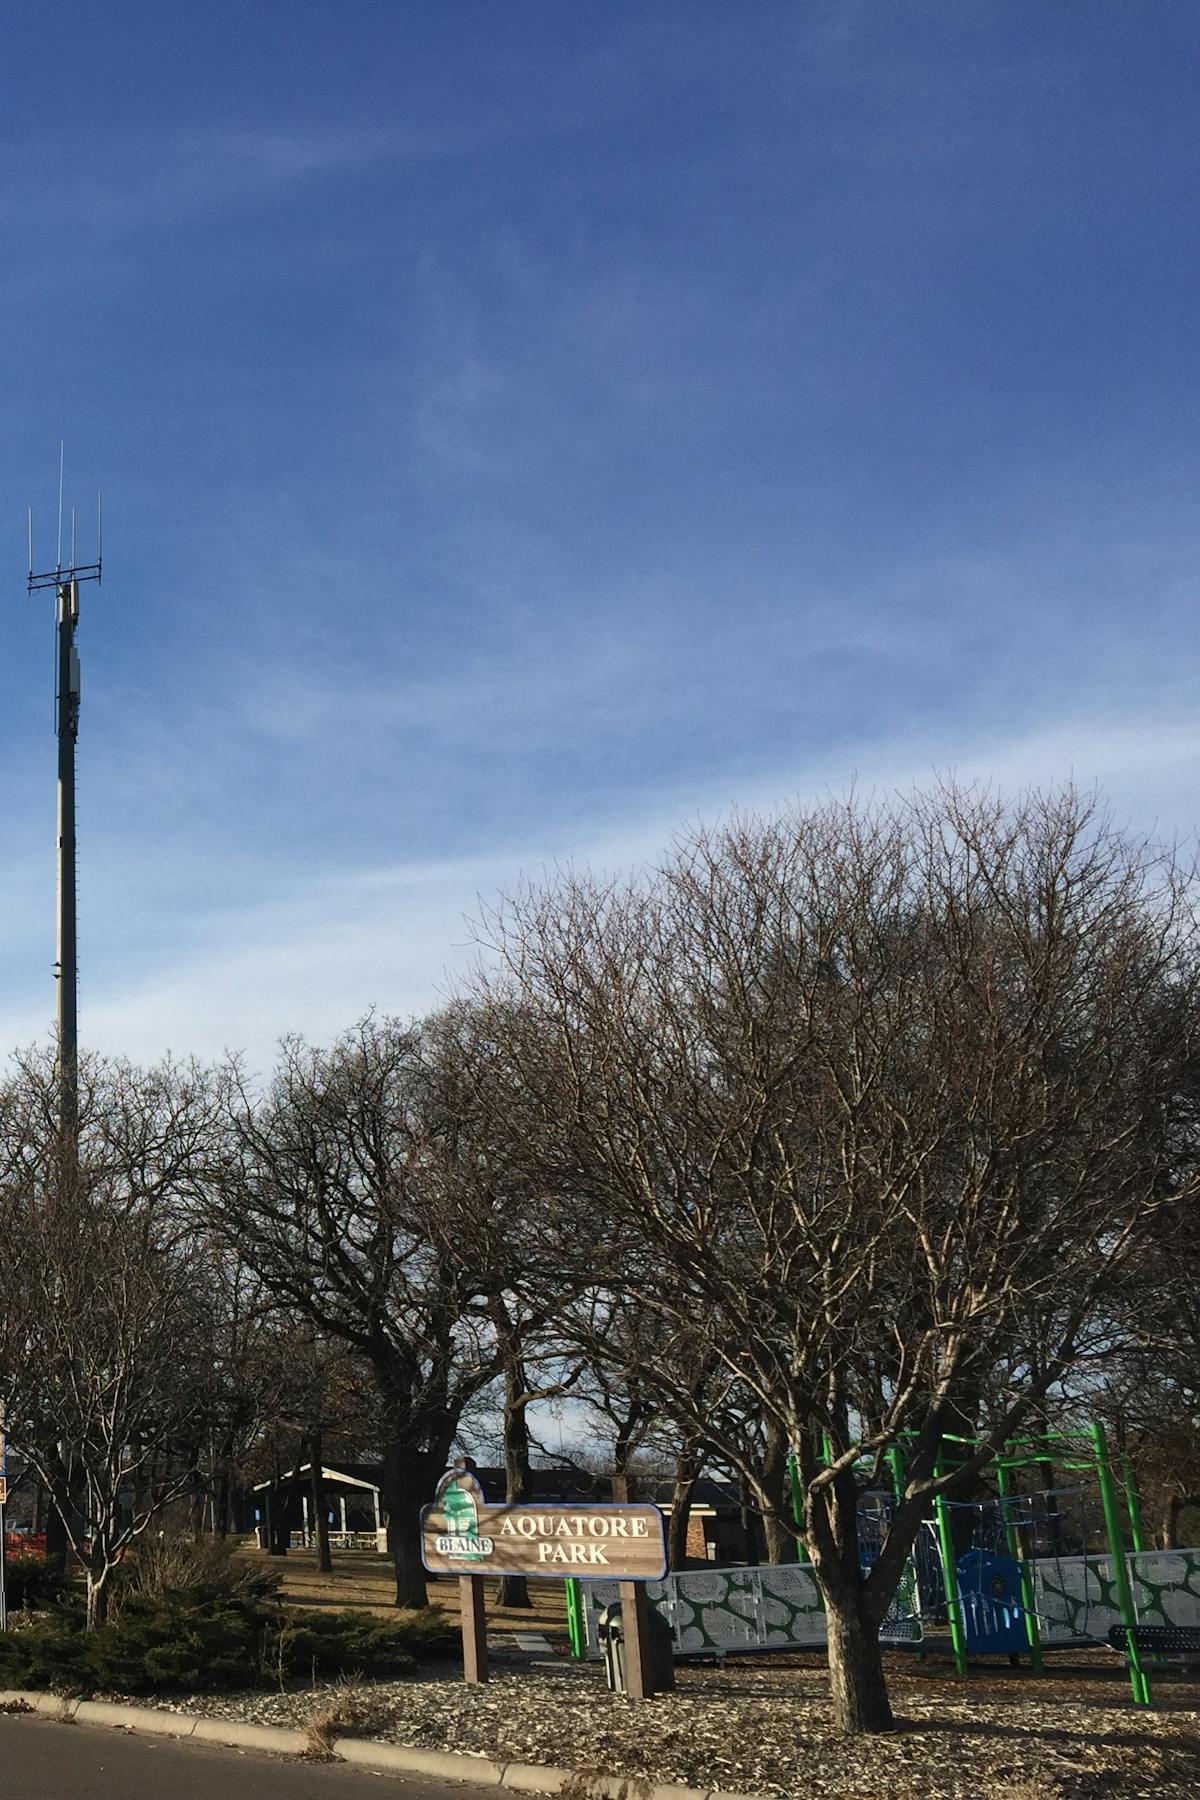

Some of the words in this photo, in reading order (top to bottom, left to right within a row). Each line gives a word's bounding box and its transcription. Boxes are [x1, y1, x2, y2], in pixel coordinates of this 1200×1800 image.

[500, 1515, 649, 1540] AQUATORE
[439, 1538, 490, 1552] BLAINE
[537, 1543, 610, 1565] PARK
